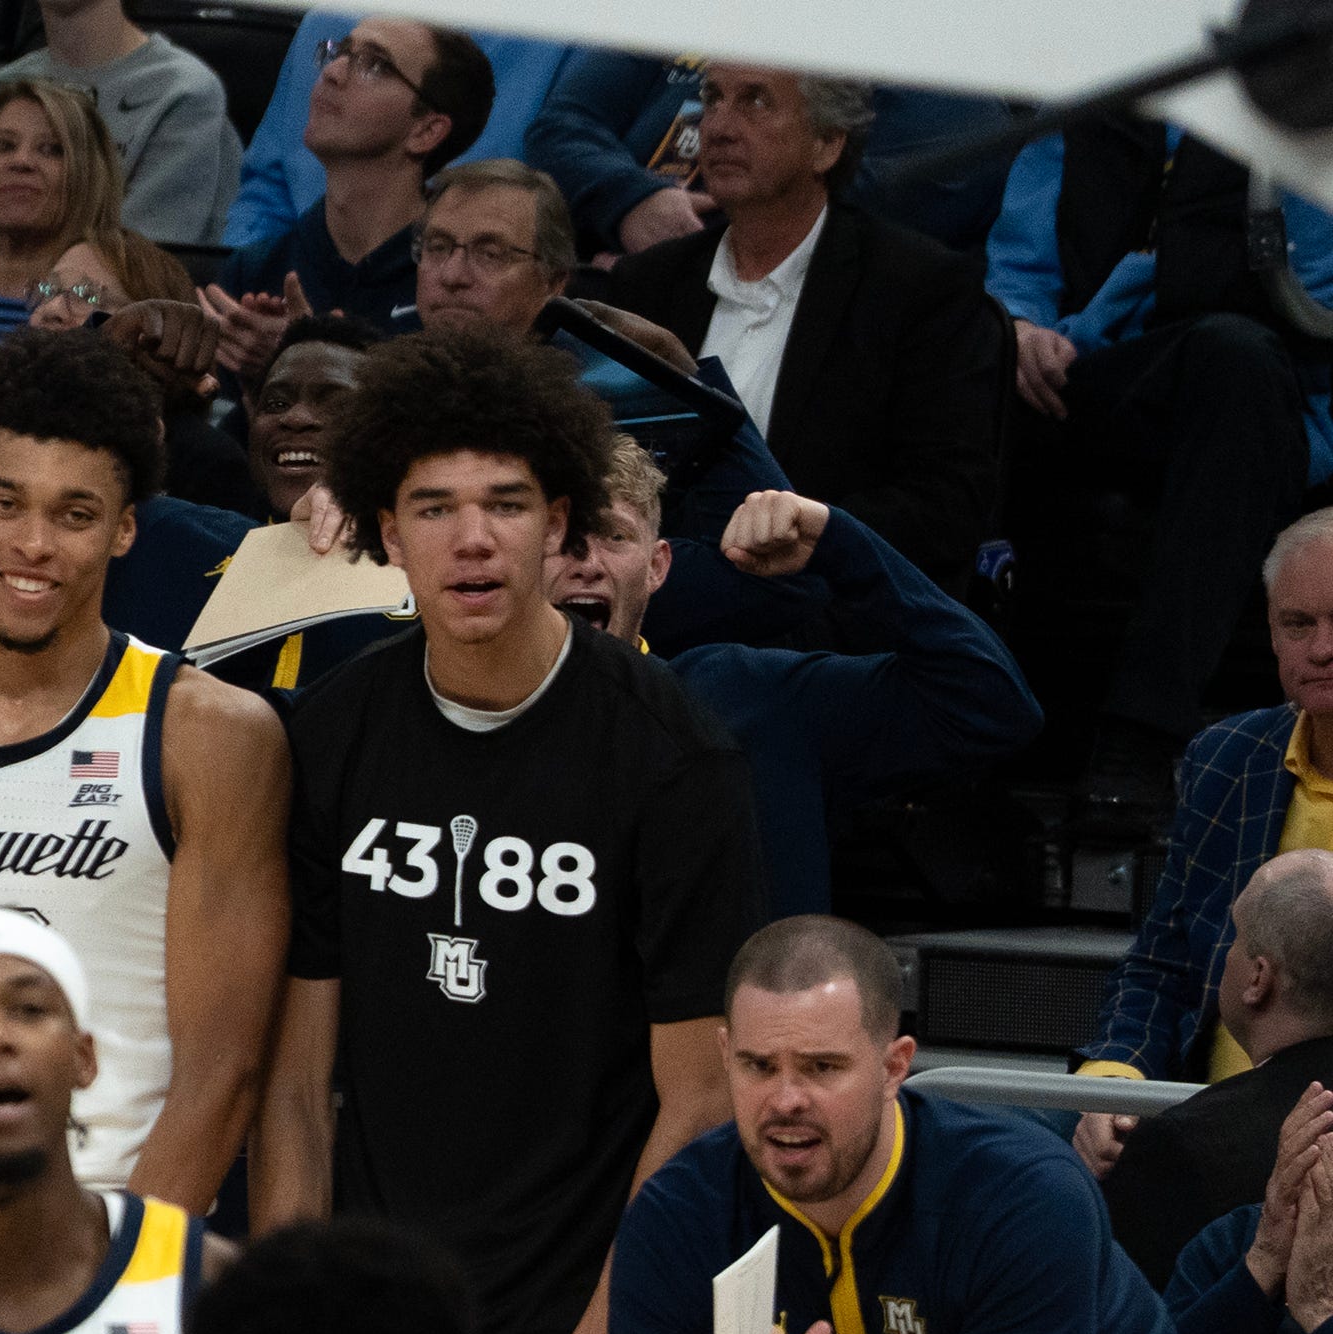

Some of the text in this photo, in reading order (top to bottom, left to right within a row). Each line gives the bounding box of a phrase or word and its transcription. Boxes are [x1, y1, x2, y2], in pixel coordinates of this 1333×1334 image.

[71, 793, 123, 804] EAST
[78, 783, 113, 794] BIG
[341, 817, 598, 916] 43 88
[426, 932, 488, 1003] MU
